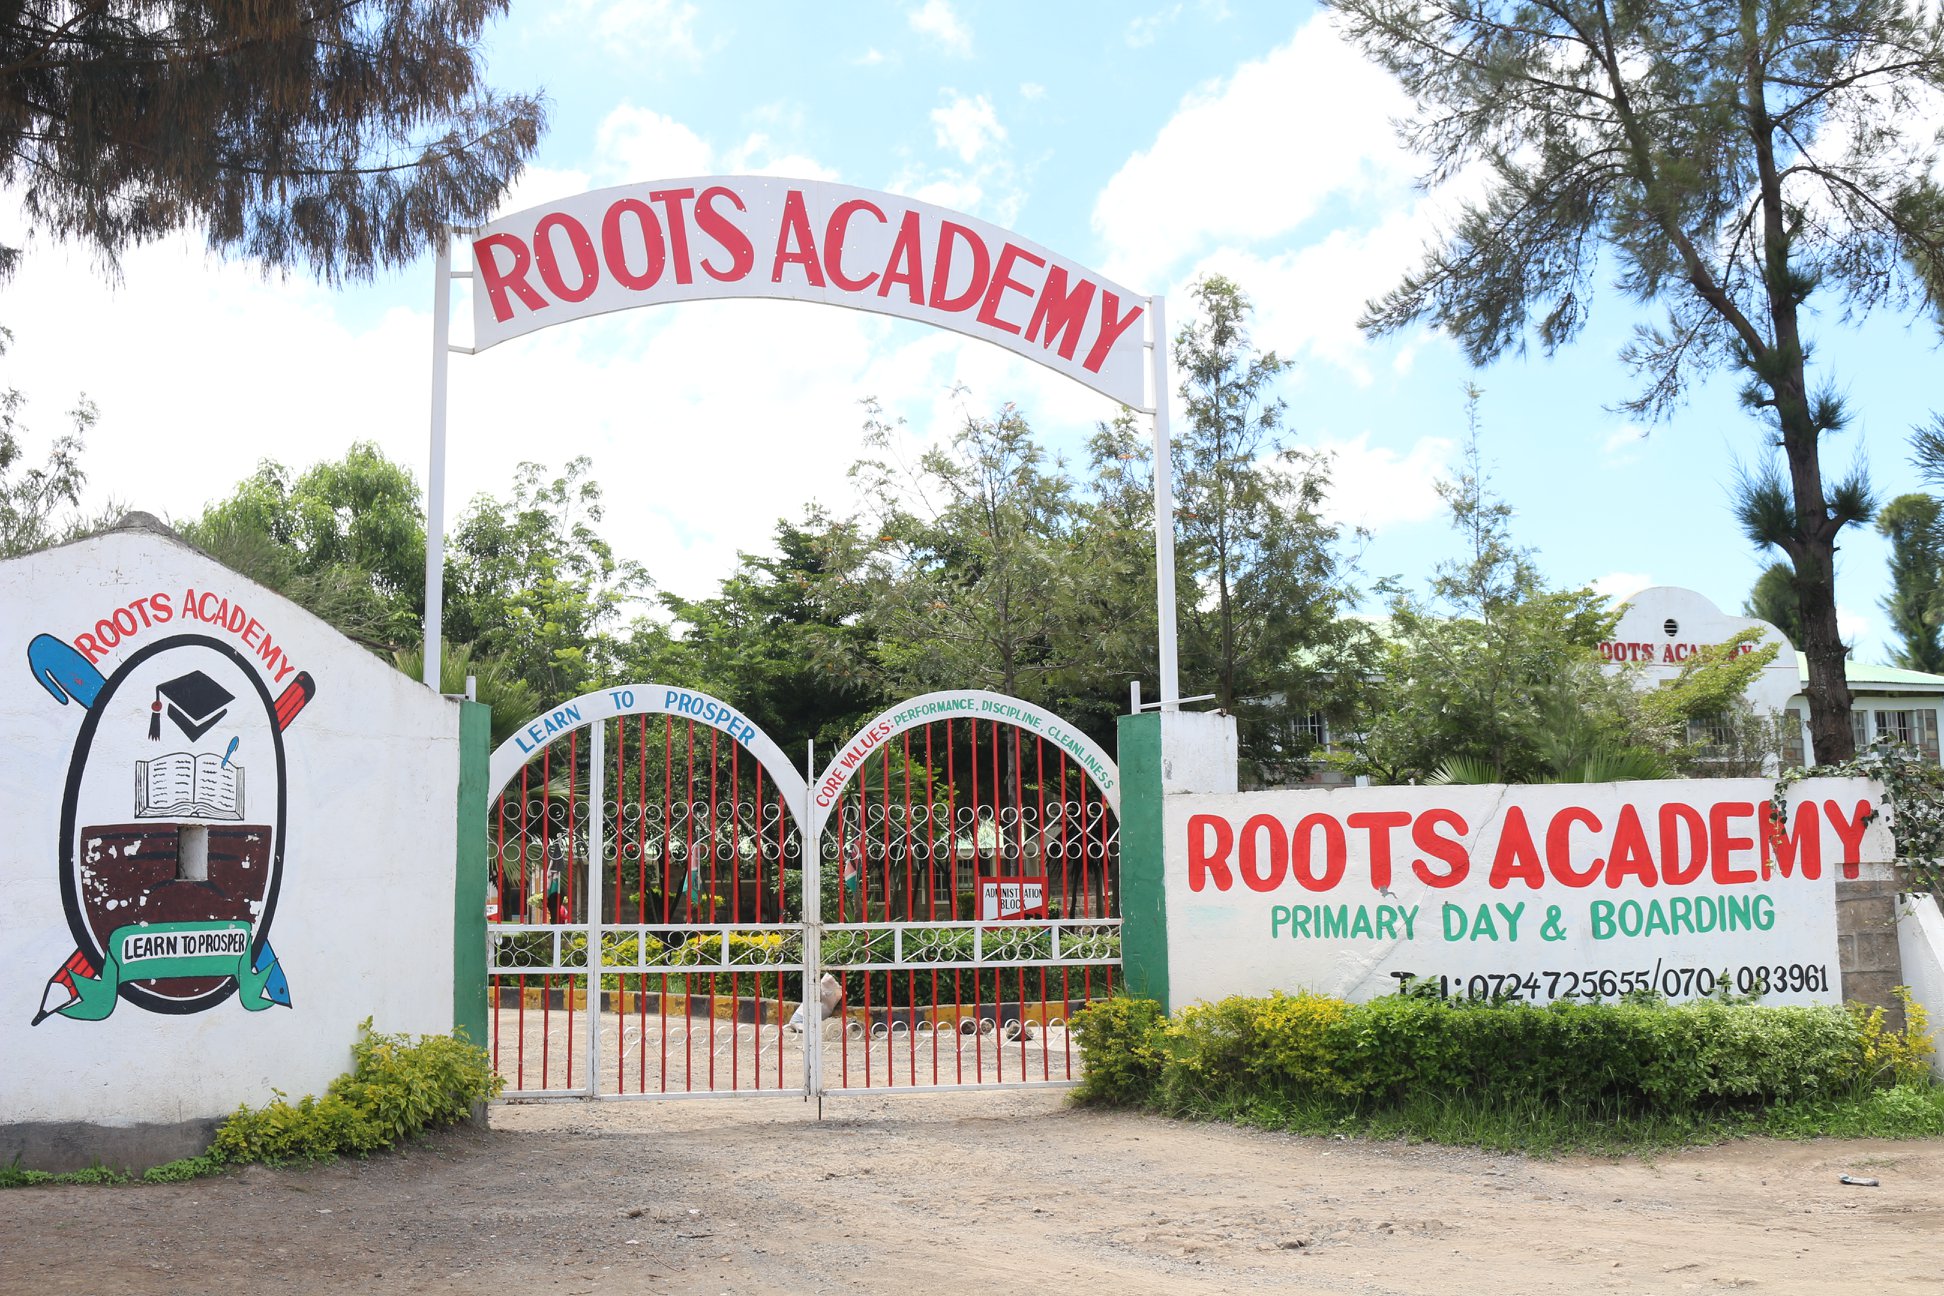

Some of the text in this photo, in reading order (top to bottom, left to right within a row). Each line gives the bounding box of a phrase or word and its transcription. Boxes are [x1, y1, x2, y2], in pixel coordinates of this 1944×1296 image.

[472, 186, 1144, 373] ROOTS ACADEMY
[73, 588, 295, 683] ROOTS ACADEMY
[1593, 641, 1655, 662] OOTS
[515, 690, 756, 754] LEARN TO PROSPER
[816, 698, 1115, 808] CORE VALUES: PERFORMANCE, DISCIPLINE, CLEANLINESS
[1187, 799, 1874, 893] ROOTS ACADEMY
[985, 888, 1043, 898] ADMNISTATION
[1271, 893, 1776, 942] PRIMARY DAY & BOARDING
[124, 933, 245, 960] LEARN TO PROSPER
